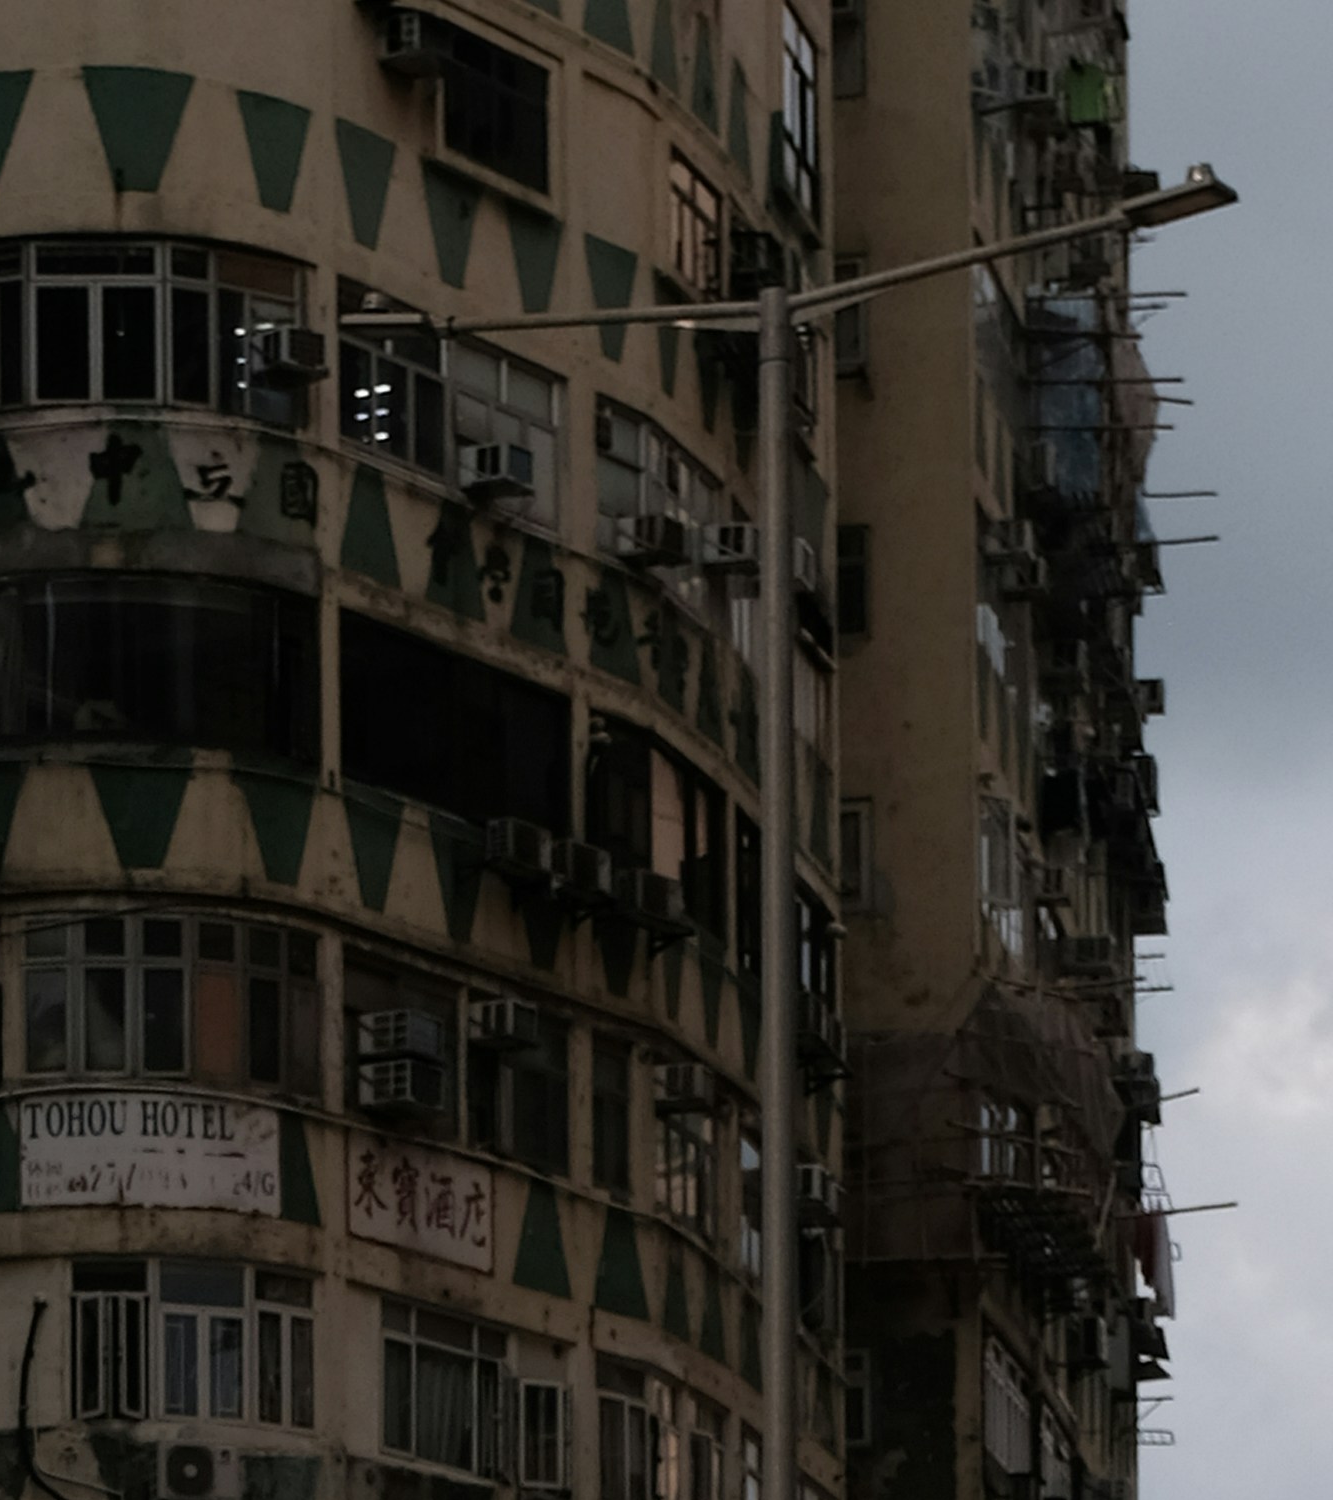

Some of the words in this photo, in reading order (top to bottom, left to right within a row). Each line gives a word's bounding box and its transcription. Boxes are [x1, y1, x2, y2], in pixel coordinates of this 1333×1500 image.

[24, 1098, 128, 1140] TOHOU
[140, 1098, 236, 1141] HOTEL
[356, 1144, 488, 1248] 東寶酒店
